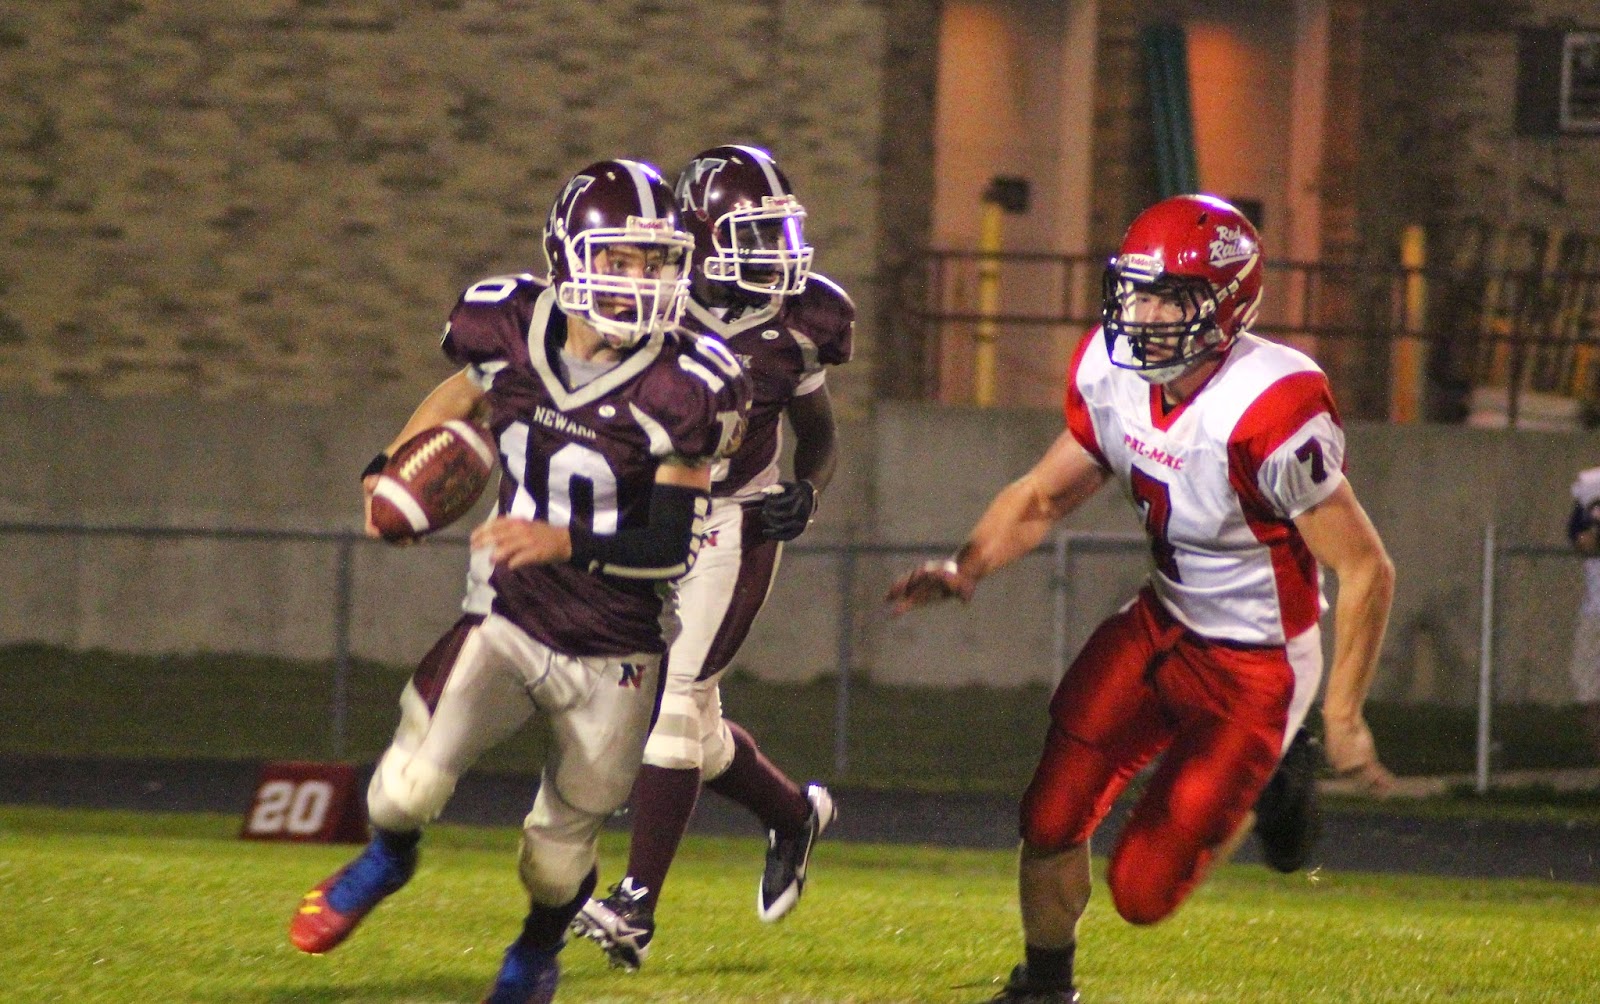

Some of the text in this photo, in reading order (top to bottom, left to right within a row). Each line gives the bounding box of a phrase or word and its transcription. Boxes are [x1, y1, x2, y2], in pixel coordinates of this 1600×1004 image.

[1215, 224, 1241, 242] Red
[677, 335, 742, 394] 10
[499, 419, 619, 536] 10
[1294, 435, 1328, 485] 7
[1130, 463, 1184, 585] 7
[618, 661, 647, 689] N
[249, 780, 335, 834] 20
